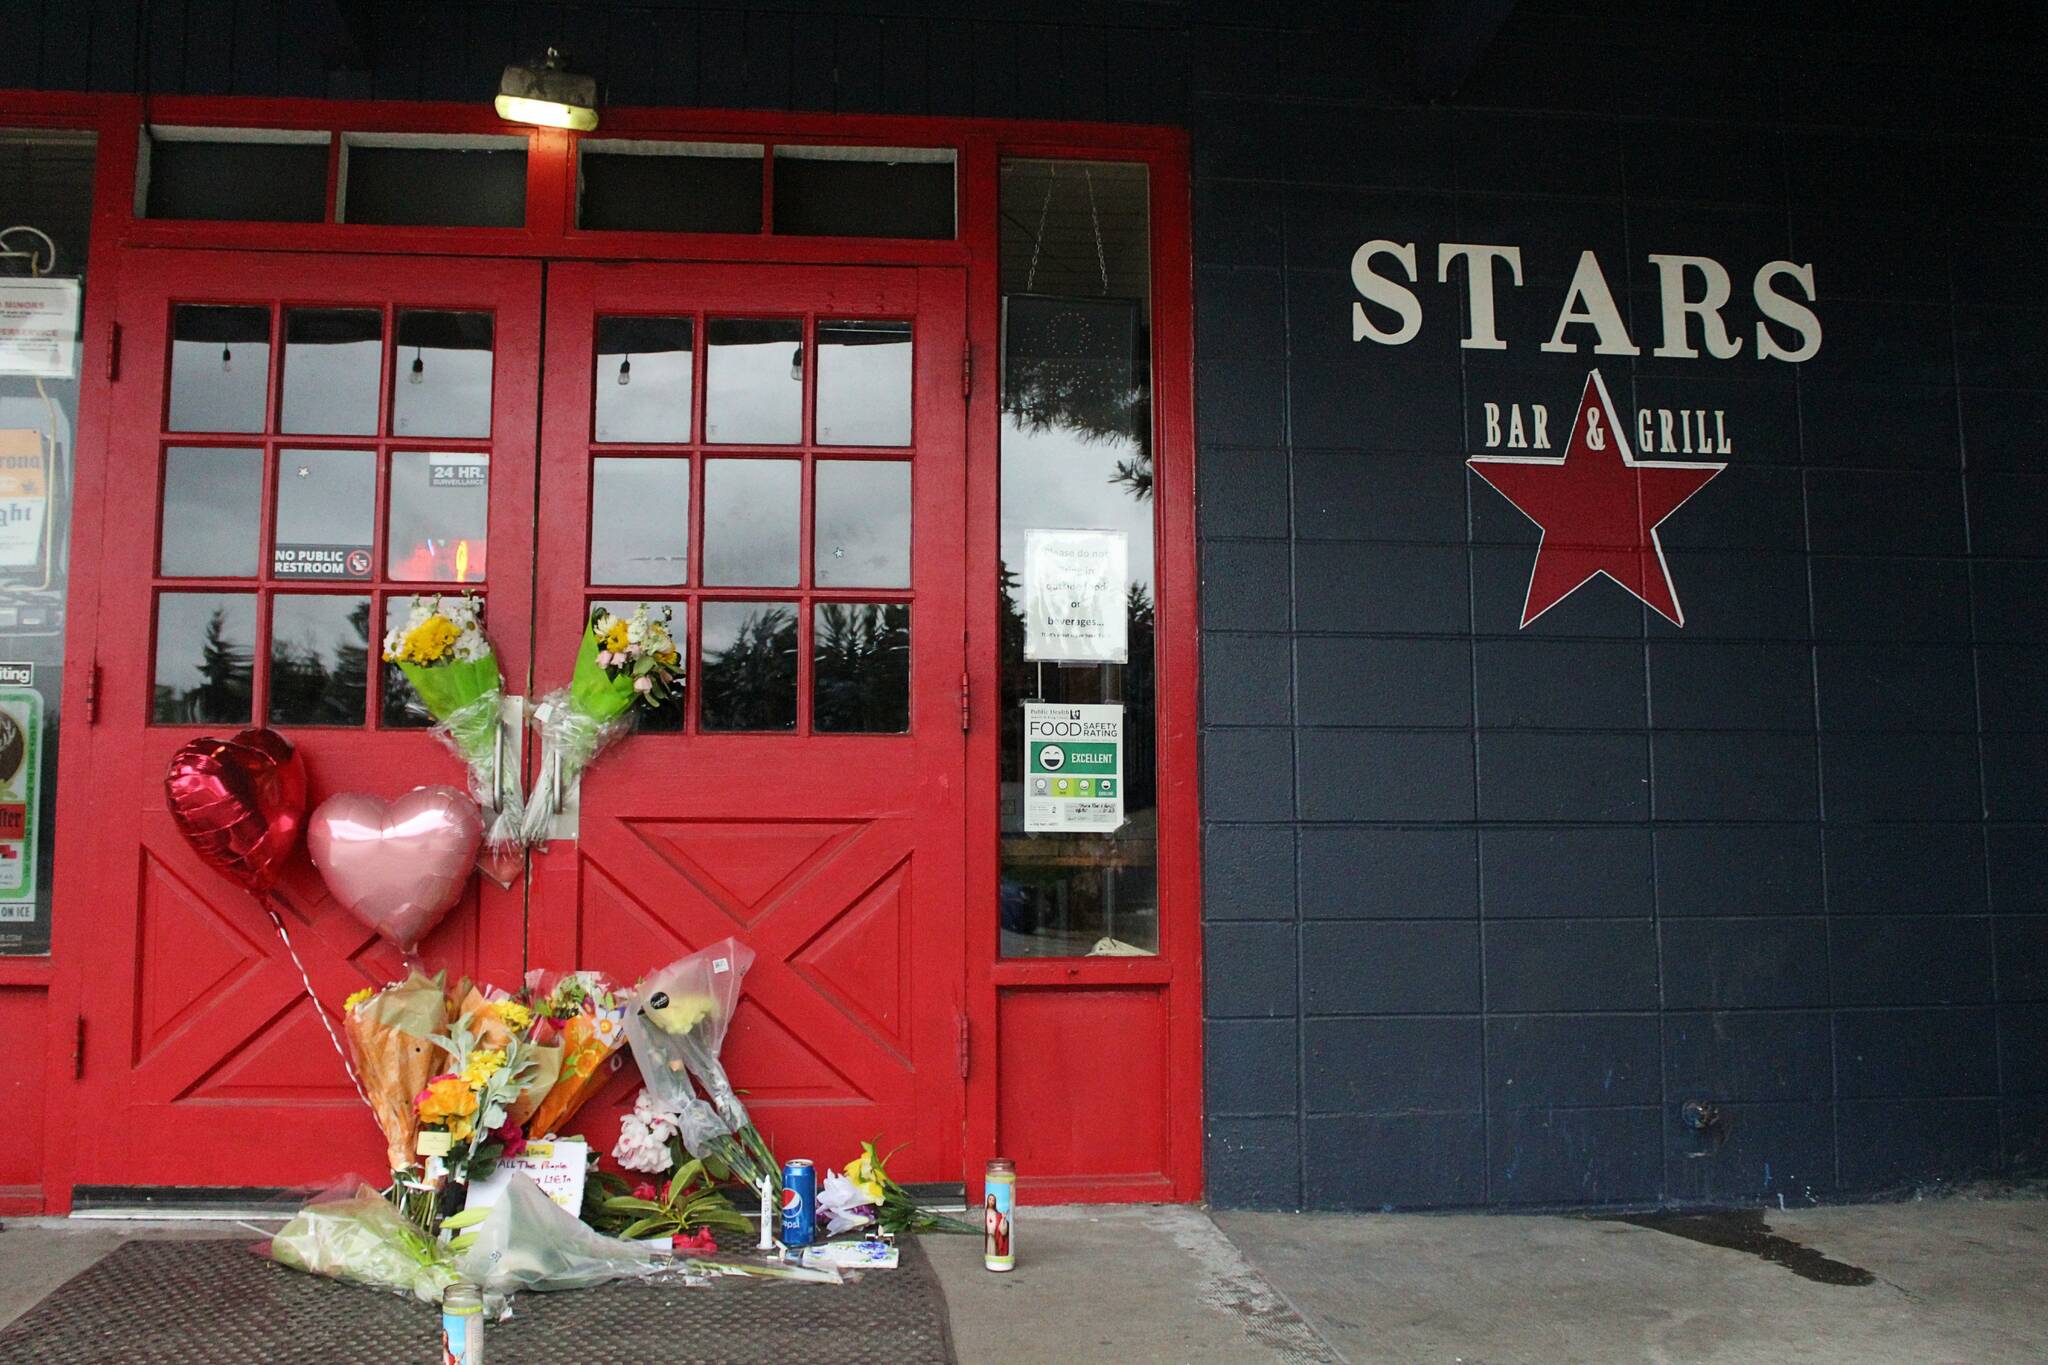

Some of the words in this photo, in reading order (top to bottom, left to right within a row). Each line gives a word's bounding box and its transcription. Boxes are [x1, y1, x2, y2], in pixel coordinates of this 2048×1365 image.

[1351, 239, 1822, 362] STARS
[1484, 402, 1551, 449] BAR
[1586, 407, 1606, 451] &
[1638, 408, 1732, 454] GRILL
[434, 466, 454, 478] 24
[458, 466, 485, 478] HR.
[433, 478, 484, 486] SURVEILLANCE
[275, 550, 295, 561] NO
[298, 551, 343, 562] PUBLIC
[1077, 549, 1089, 558] do
[274, 562, 344, 573] RESTROOM
[1083, 581, 1106, 591] fod
[1047, 616, 1104, 628] bverges...
[1030, 721, 1082, 736] FOOD
[1083, 722, 1117, 730] SAFETY
[1083, 730, 1118, 738] RATING
[1071, 753, 1112, 763] EXCELLENT
[16, 907, 30, 917] ICE
